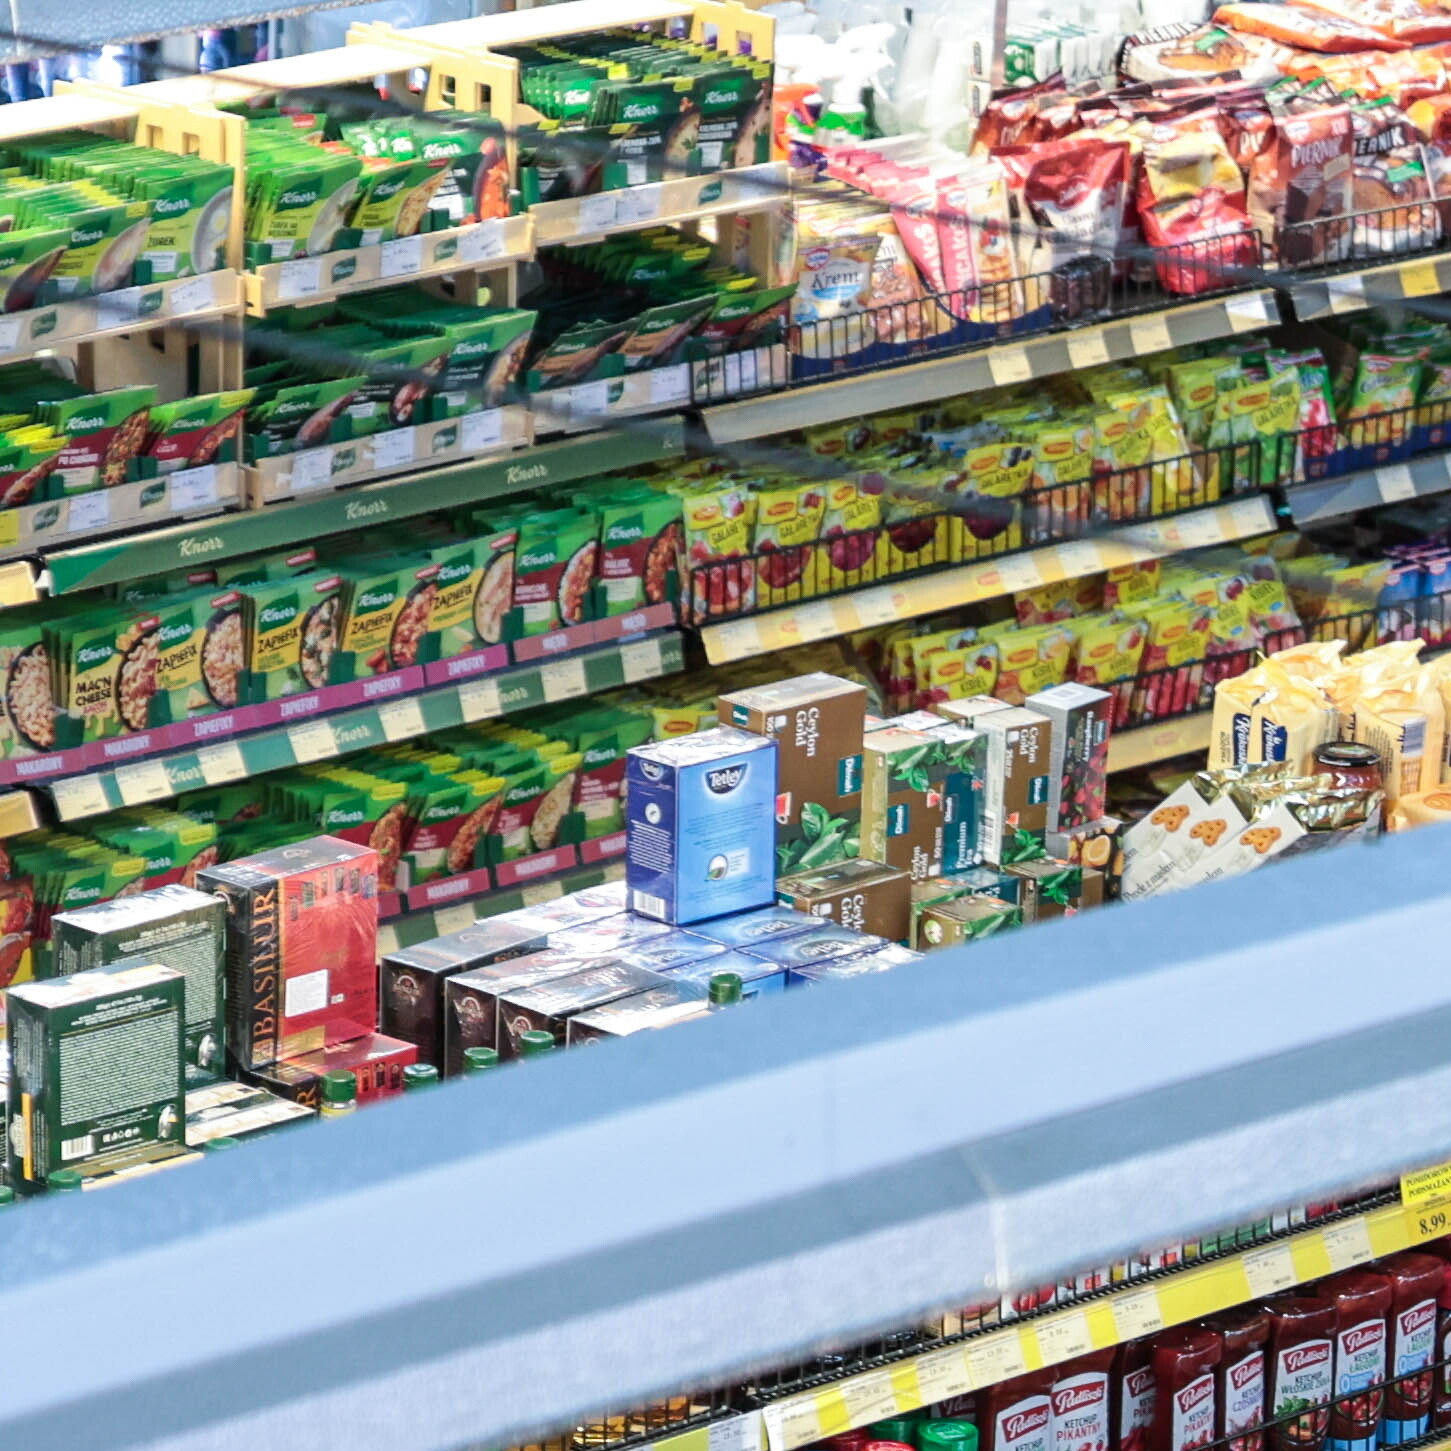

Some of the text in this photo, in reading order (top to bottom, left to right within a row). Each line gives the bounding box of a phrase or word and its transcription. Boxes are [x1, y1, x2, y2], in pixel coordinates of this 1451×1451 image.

[810, 270, 858, 290] Krem
[506, 464, 549, 484] Knorr
[346, 500, 389, 519] Knorr
[178, 537, 224, 557] Knorr
[795, 706, 807, 747] Gold
[807, 706, 820, 757] Ceylon
[709, 764, 744, 787] Tetley
